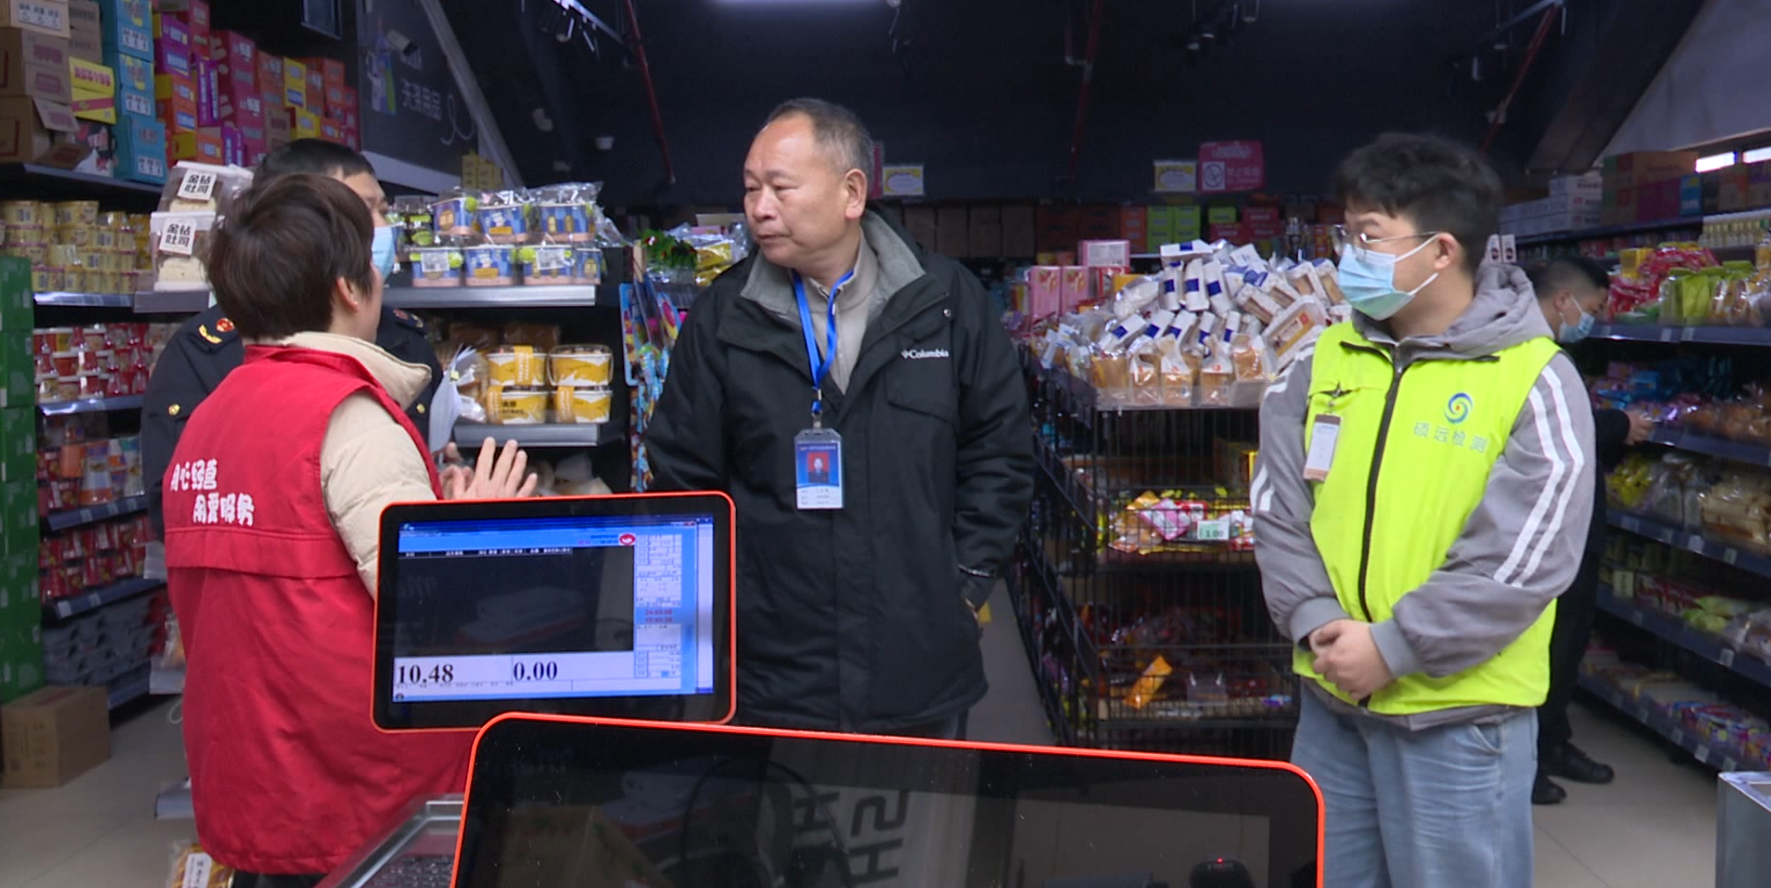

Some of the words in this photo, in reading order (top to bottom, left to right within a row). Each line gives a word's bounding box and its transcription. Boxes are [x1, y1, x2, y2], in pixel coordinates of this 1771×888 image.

[167, 224, 191, 236] 金钻
[909, 348, 949, 359] Columbia
[1413, 421, 1489, 454] 硕远检测
[397, 664, 454, 685] 10.48
[513, 661, 558, 681] 0.00
